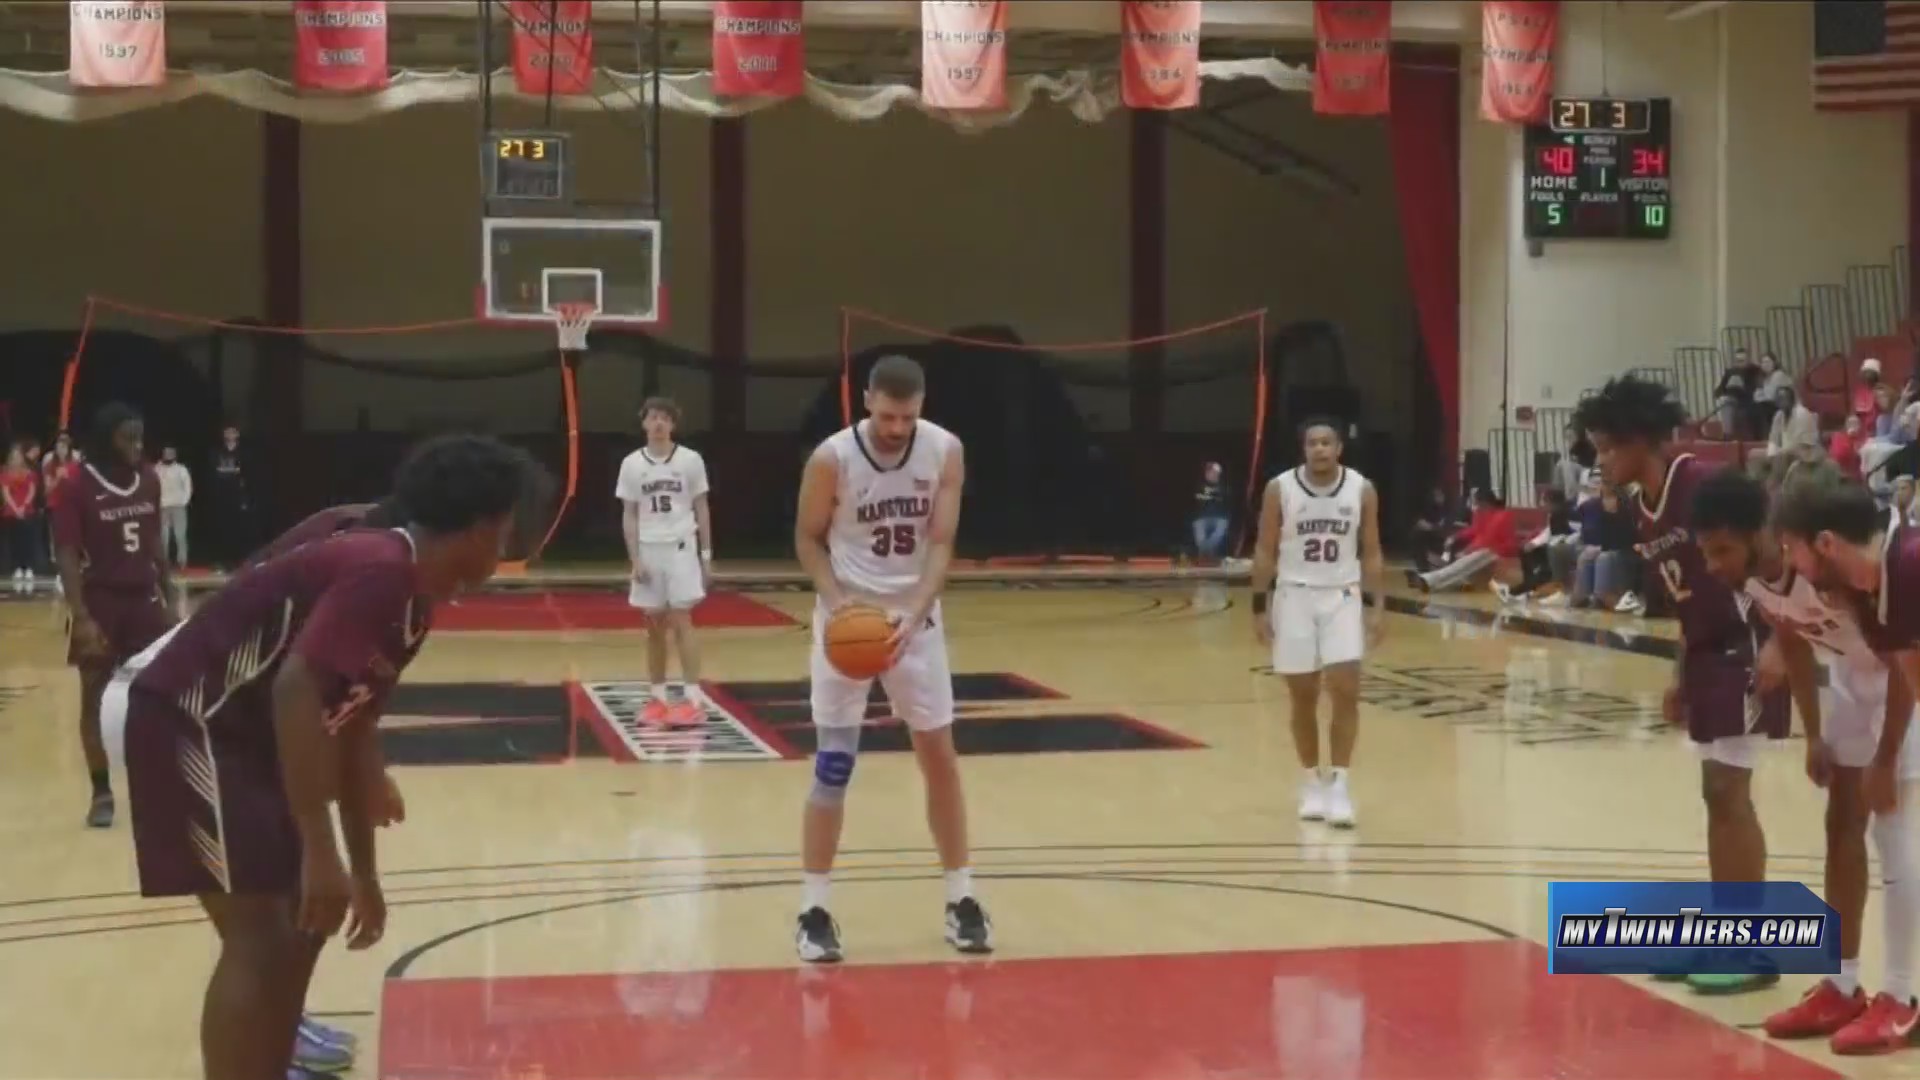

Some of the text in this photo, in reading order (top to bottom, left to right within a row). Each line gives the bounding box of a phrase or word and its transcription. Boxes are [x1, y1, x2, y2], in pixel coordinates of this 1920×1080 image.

[1559, 101, 1626, 129] 27 3
[500, 139, 545, 159] 27 3
[1543, 147, 1574, 174] 40
[1632, 149, 1665, 175] 34
[1530, 176, 1577, 189] HOME
[1547, 203, 1561, 225] 5
[1645, 204, 1665, 227] 10
[122, 521, 140, 552] 5
[871, 524, 917, 558] 35
[1303, 538, 1339, 563] 20
